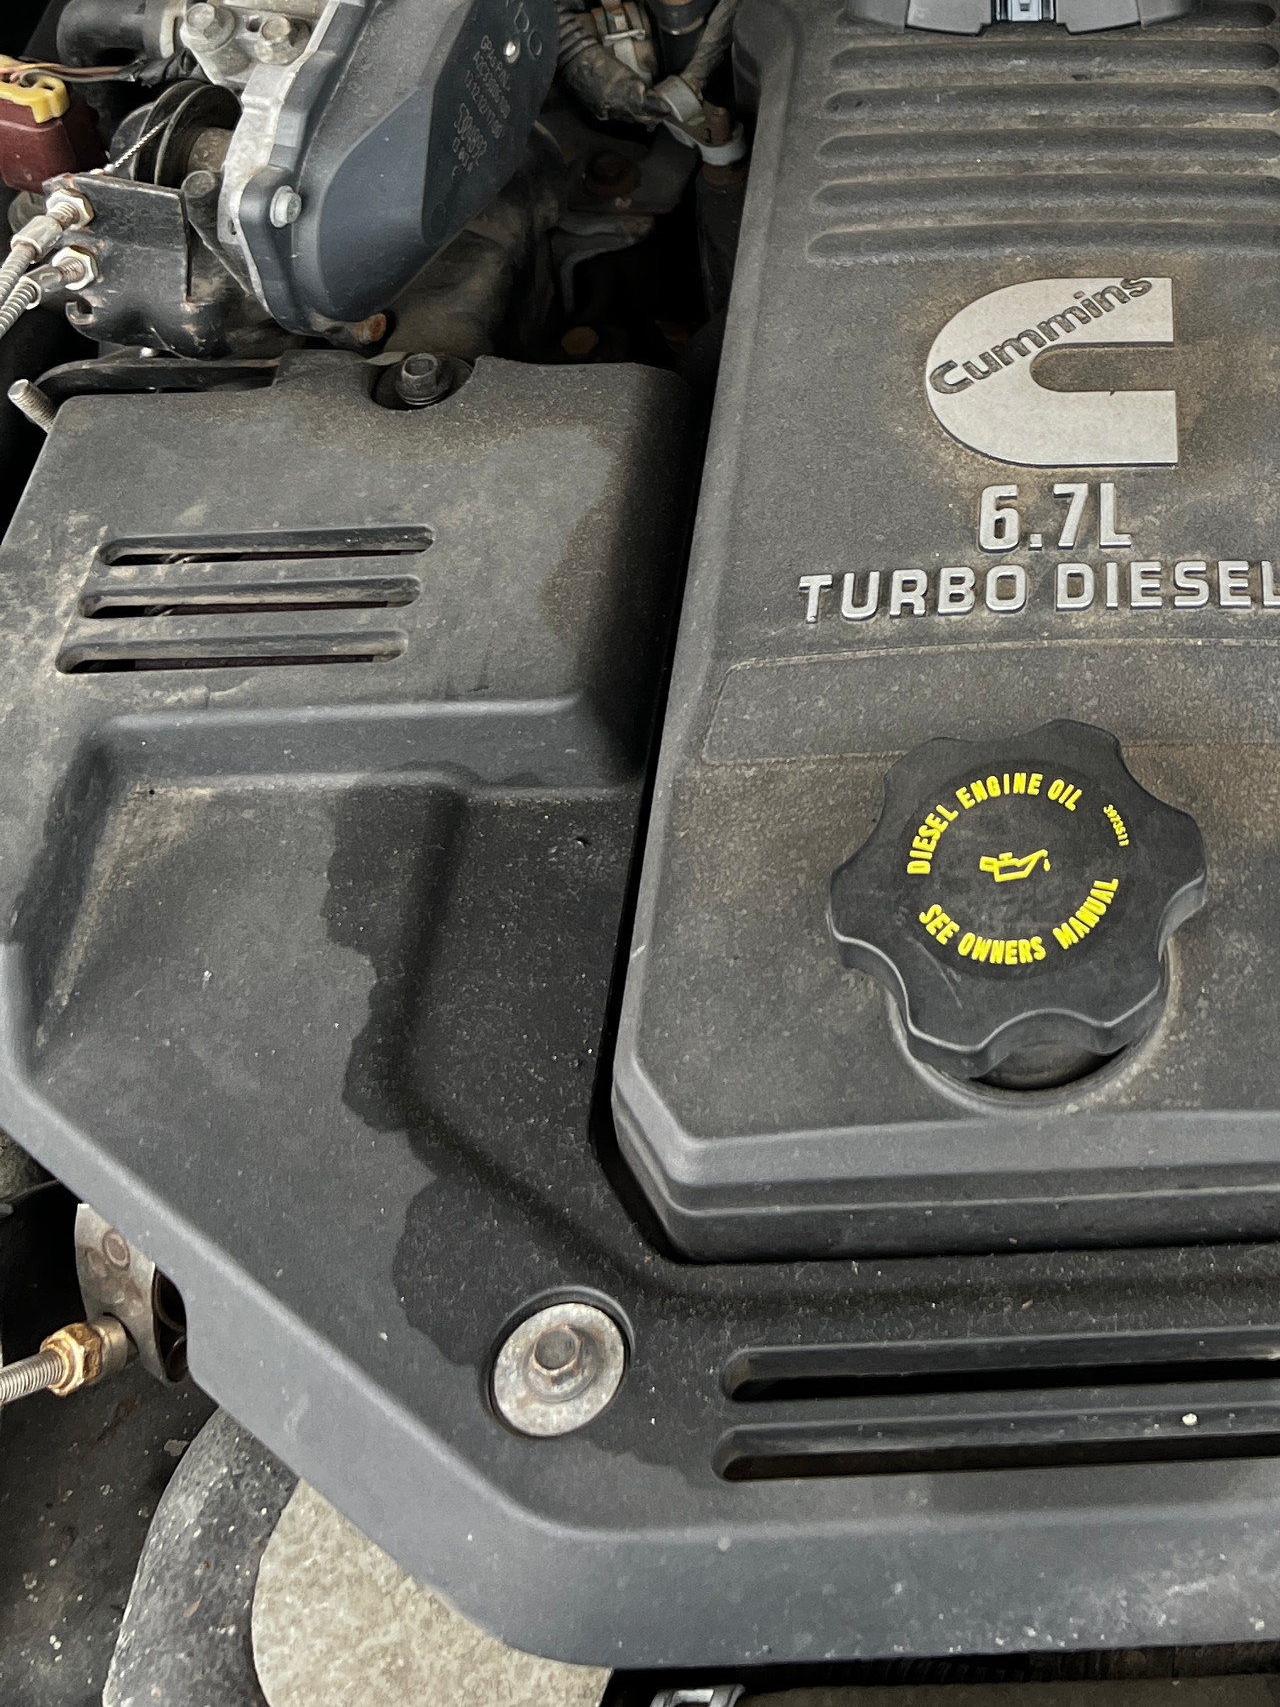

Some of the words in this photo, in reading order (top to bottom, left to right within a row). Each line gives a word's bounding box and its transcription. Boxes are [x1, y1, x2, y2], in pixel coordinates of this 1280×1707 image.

[928, 276, 1153, 395] Cummins
[977, 482, 1132, 553] 6.7L
[799, 564, 1028, 623] TURBO
[906, 804, 959, 875] DIESEL
[955, 772, 1043, 810] ENGINE
[1047, 778, 1083, 812] OIL
[918, 904, 960, 946] SEE
[957, 932, 1046, 965] OWNERS
[1052, 878, 1119, 950] MANUAL
